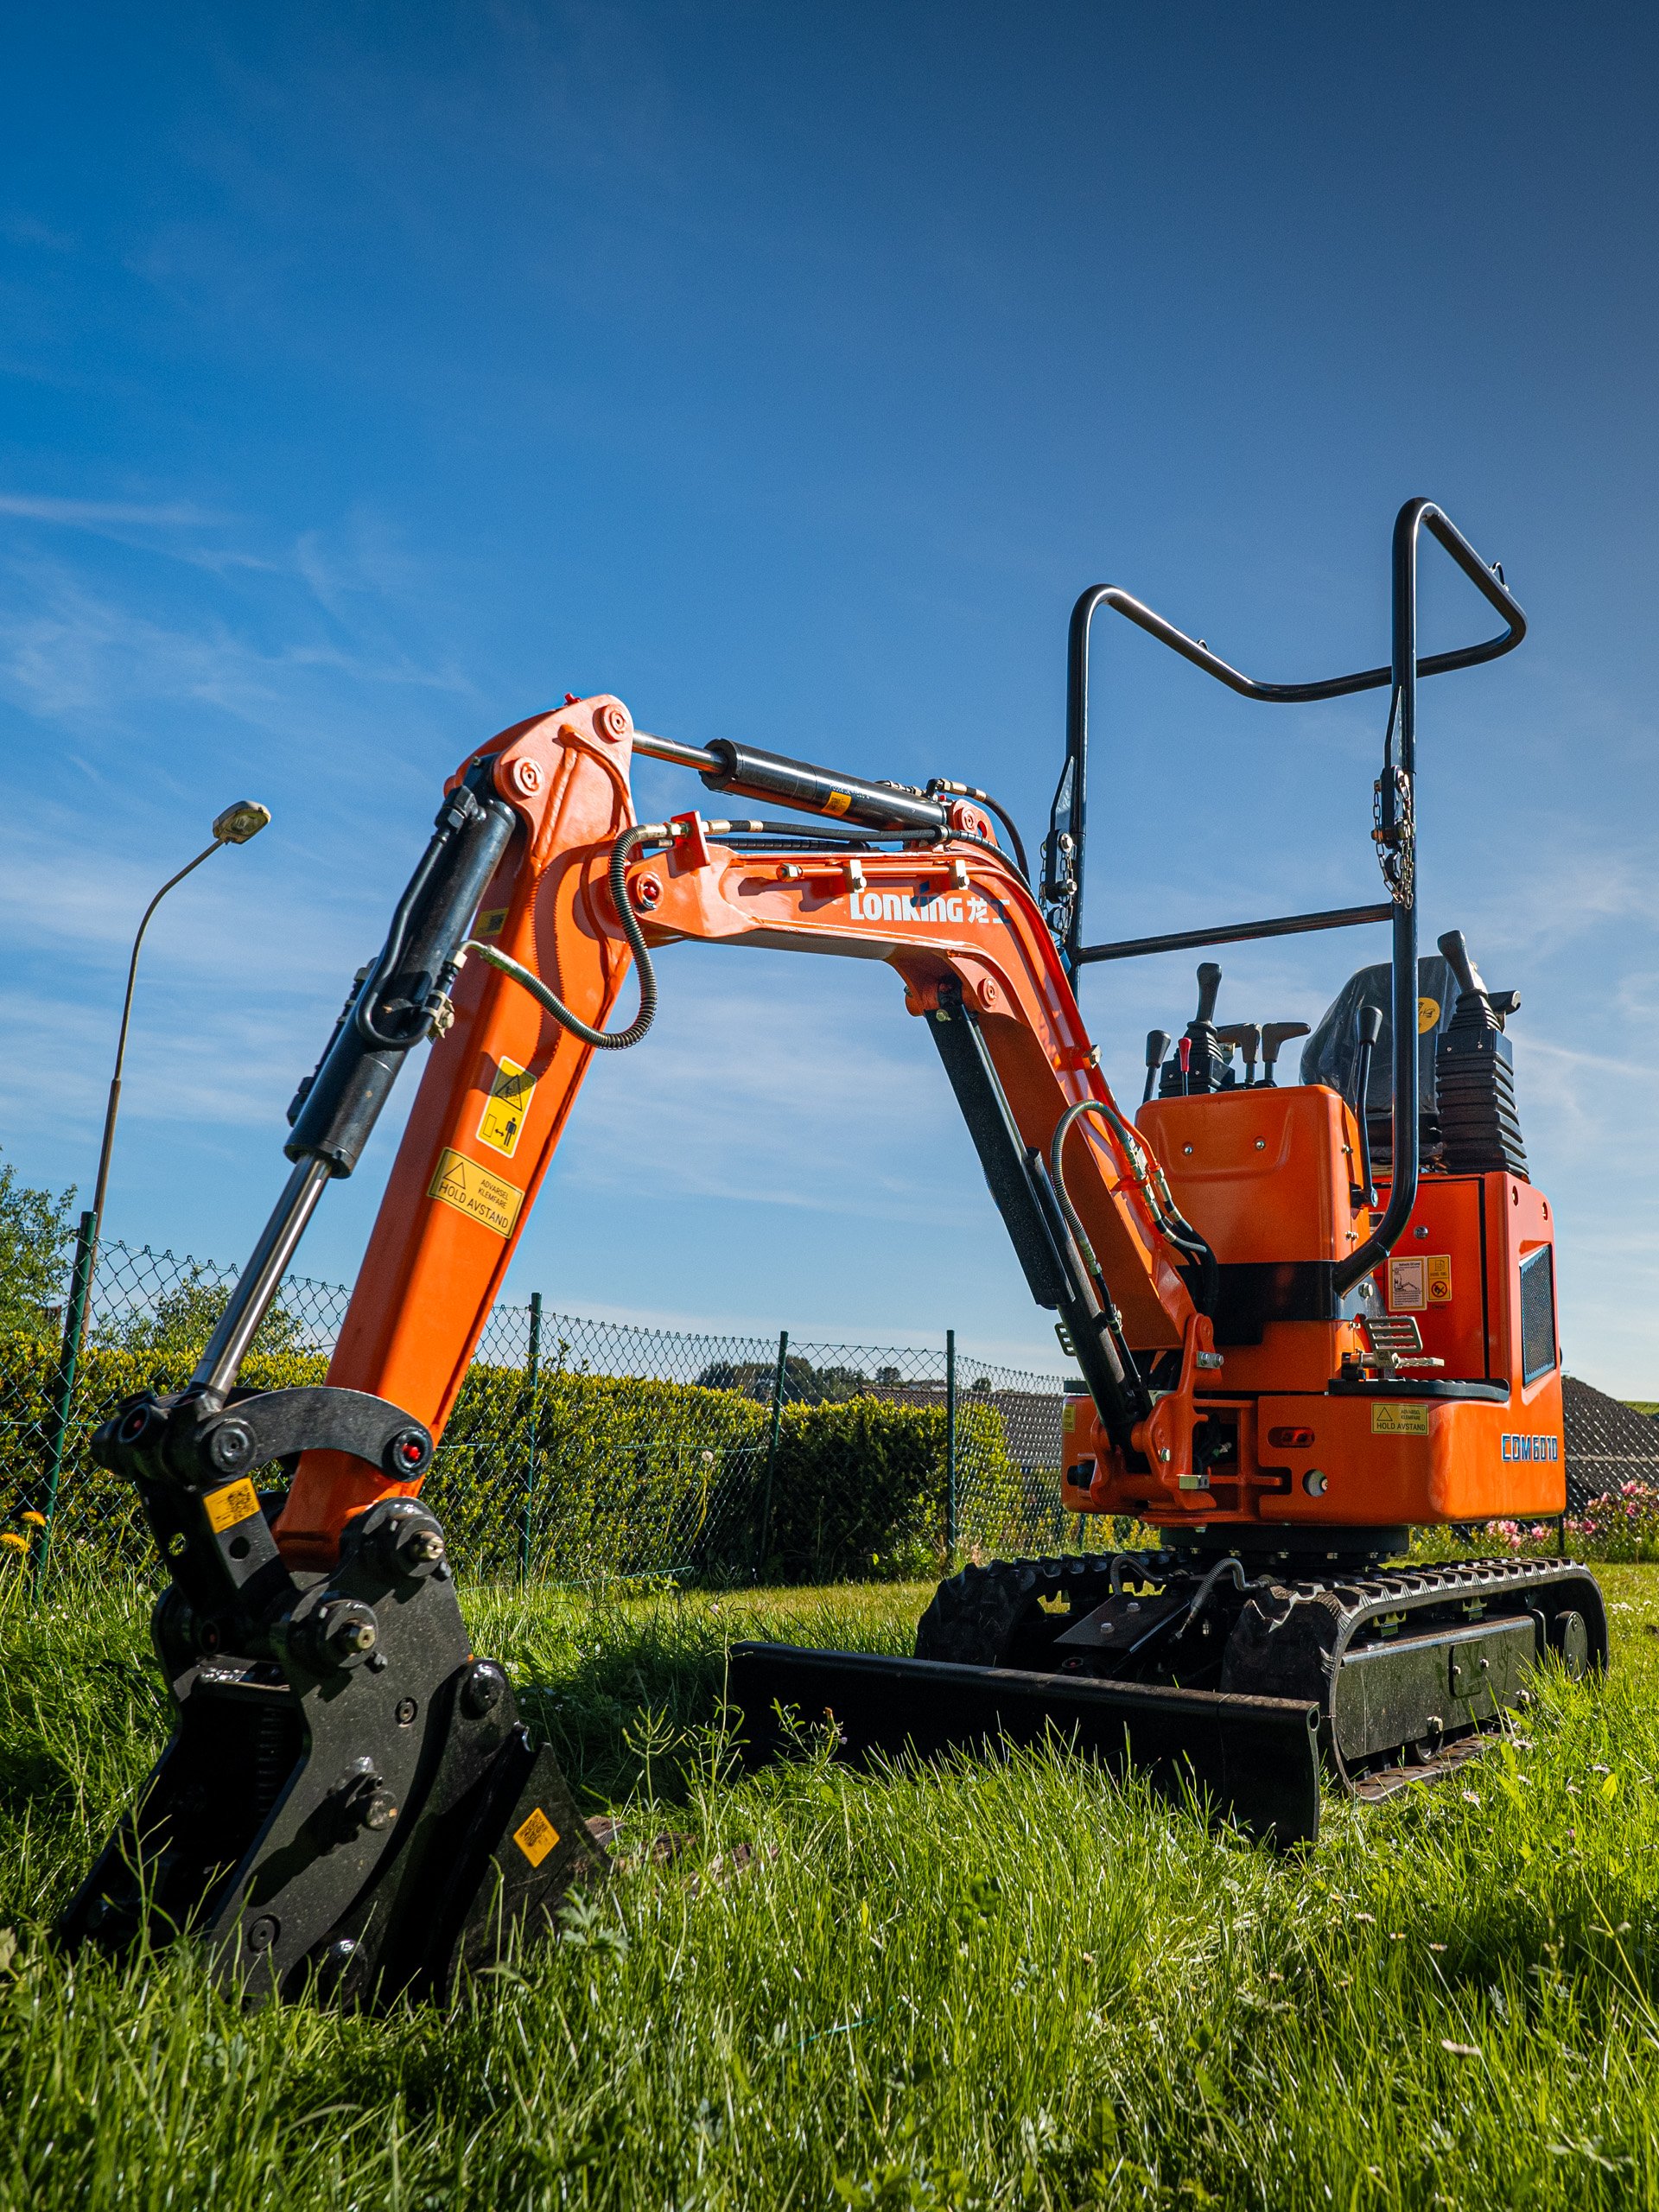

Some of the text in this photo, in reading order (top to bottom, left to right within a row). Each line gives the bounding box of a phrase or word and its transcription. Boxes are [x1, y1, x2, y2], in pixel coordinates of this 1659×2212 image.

[967, 897, 1012, 924] 龙工
[478, 1187, 508, 1210] KLEMFARE
[480, 1179, 509, 1201] ADVARSEL
[438, 1181, 509, 1229] HOLD AVSTAND
[1501, 1433, 1558, 1462] CDM6010
